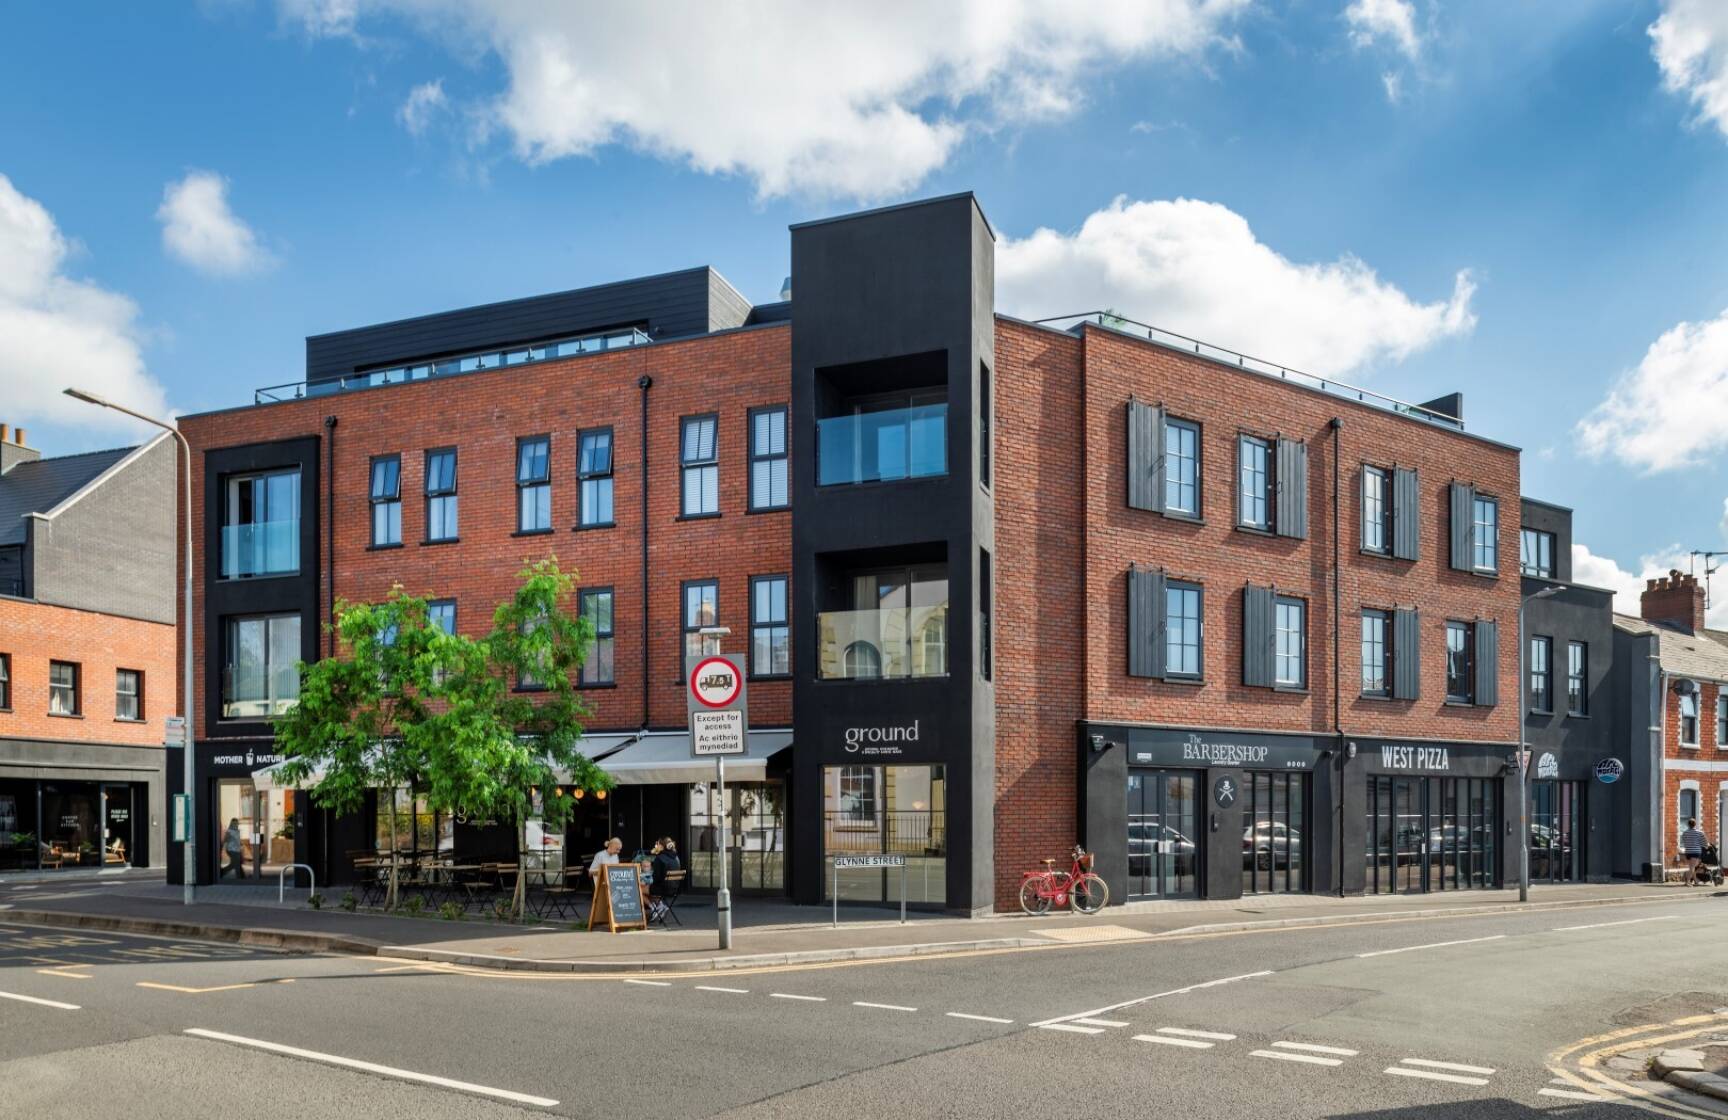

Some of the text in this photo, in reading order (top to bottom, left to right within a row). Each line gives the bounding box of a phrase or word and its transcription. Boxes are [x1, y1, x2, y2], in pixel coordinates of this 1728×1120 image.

[696, 714, 725, 723] Except
[712, 734, 738, 742] eithrio
[844, 719, 919, 753] ground
[1189, 734, 1202, 744] The
[699, 743, 738, 751] mynediad
[1183, 743, 1268, 762] BARBERSHOP
[1381, 745, 1449, 769] WEST PIZZA
[213, 755, 243, 764] MOTHER
[836, 856, 904, 866] GLYNNE STREET
